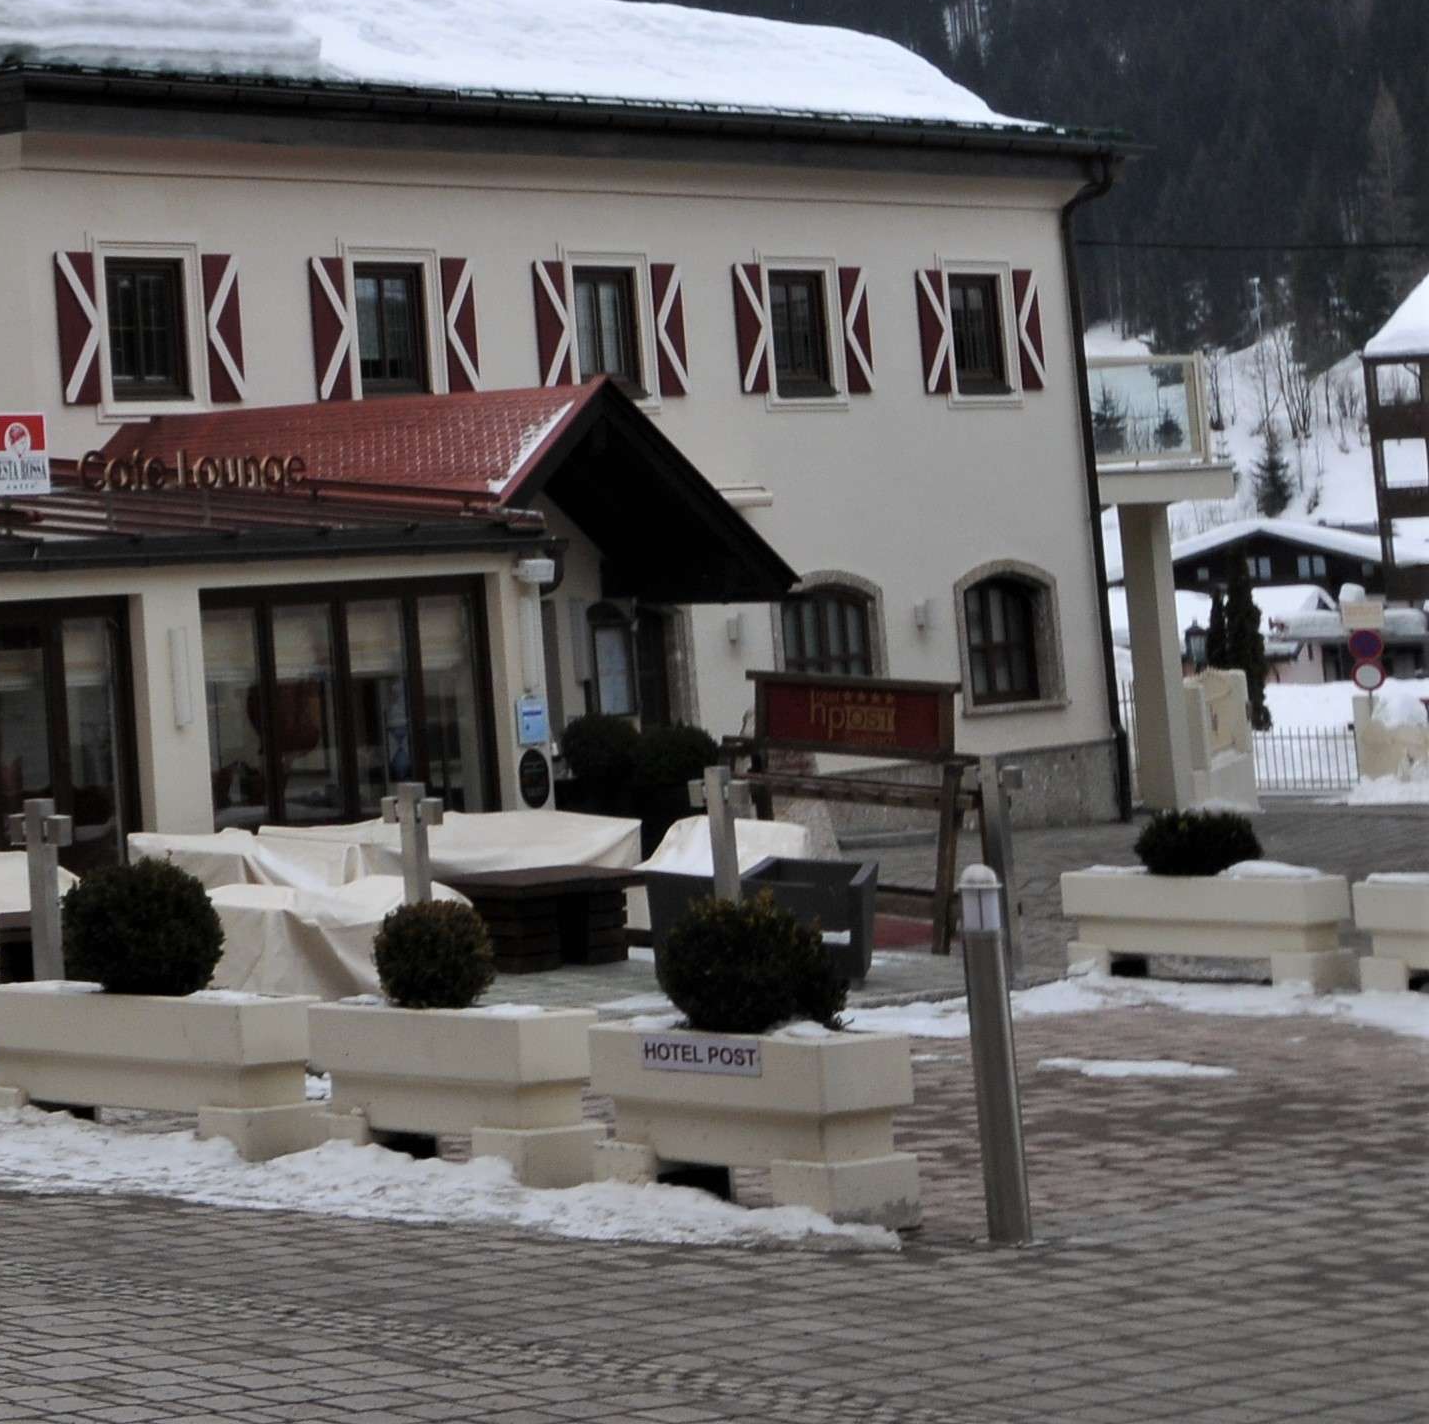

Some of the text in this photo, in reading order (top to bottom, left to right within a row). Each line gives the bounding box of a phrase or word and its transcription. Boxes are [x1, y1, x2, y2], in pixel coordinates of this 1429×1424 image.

[21, 460, 47, 480] ROSSA
[644, 1042, 757, 1067] HOTEL POST
